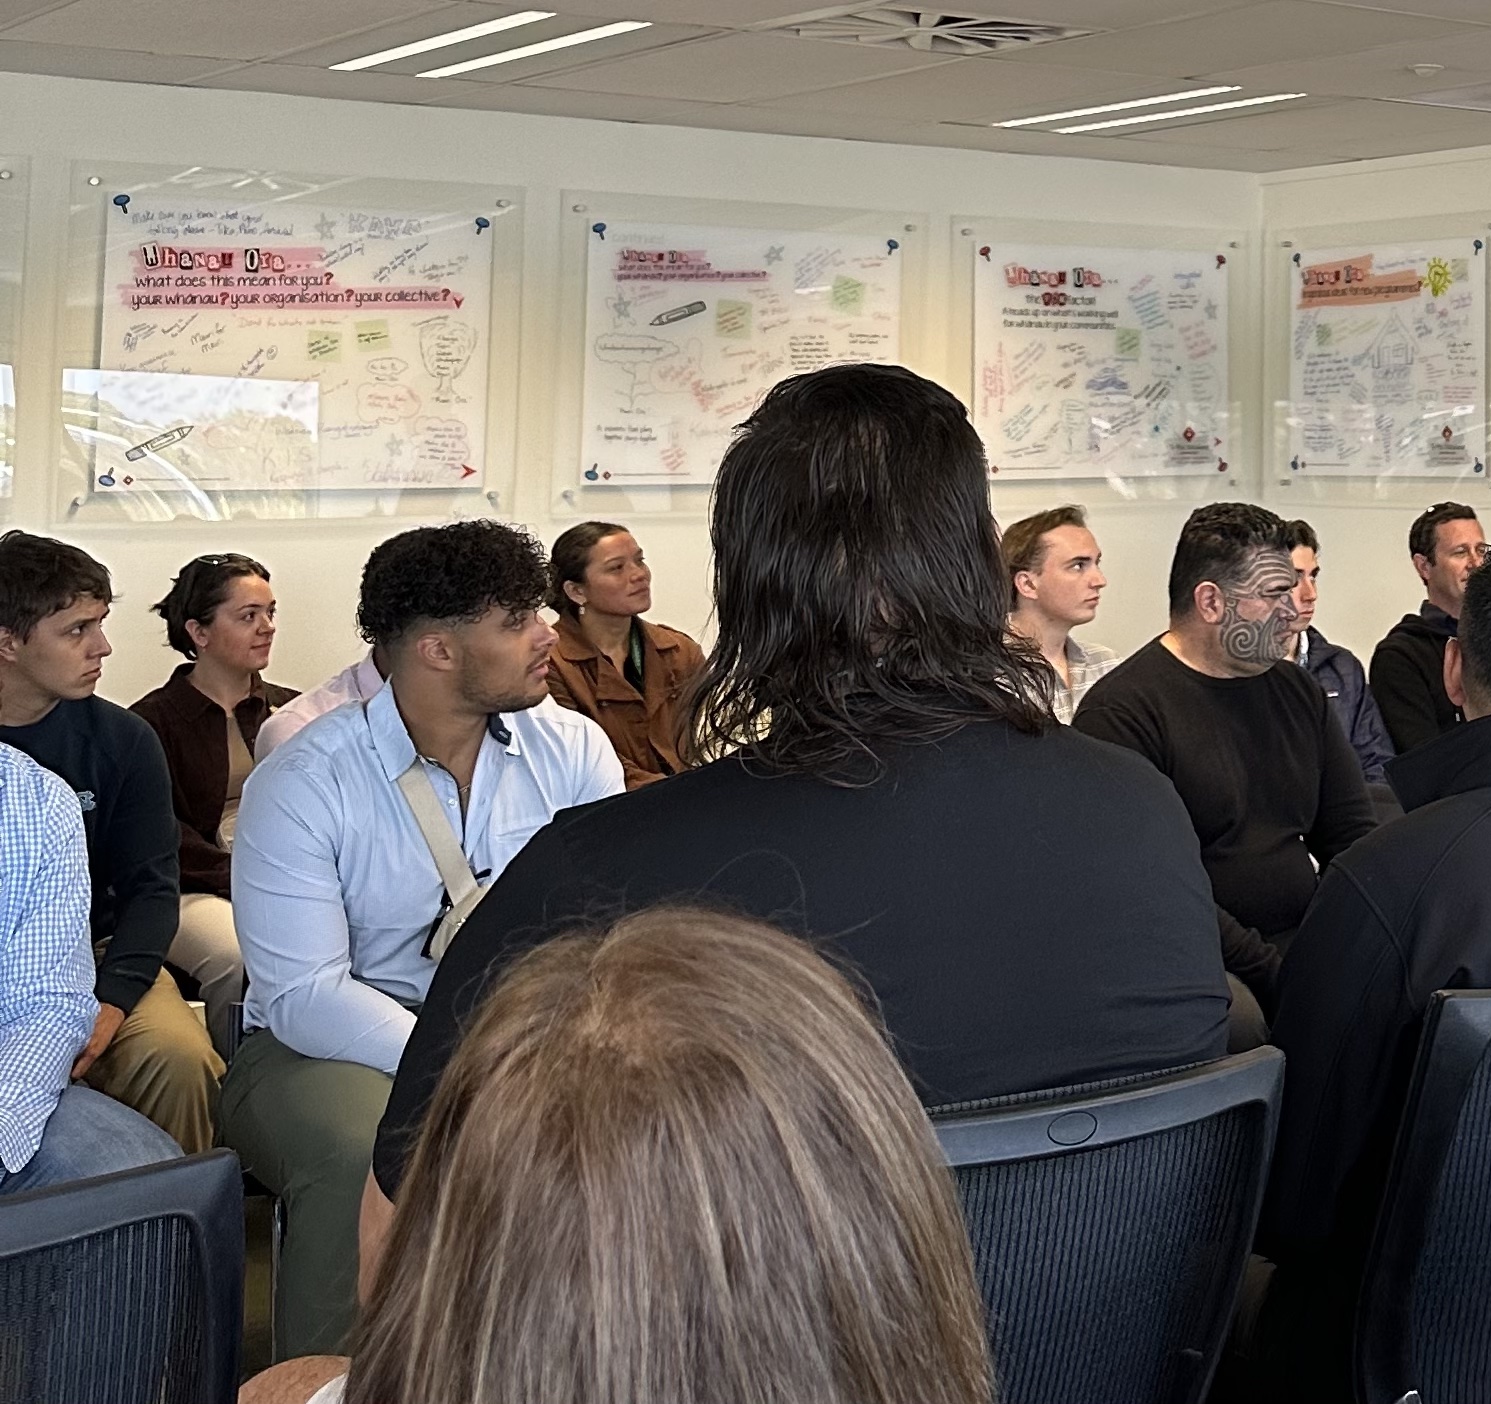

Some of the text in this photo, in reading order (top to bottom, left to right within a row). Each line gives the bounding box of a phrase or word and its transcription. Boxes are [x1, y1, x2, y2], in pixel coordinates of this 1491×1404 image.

[141, 241, 233, 271] Whanau
[135, 271, 334, 291] what does this mean for you?
[131, 293, 163, 311] your
[230, 293, 260, 310] your
[263, 288, 355, 309] organisation?
[355, 290, 383, 308] your
[385, 288, 451, 302] collective?
